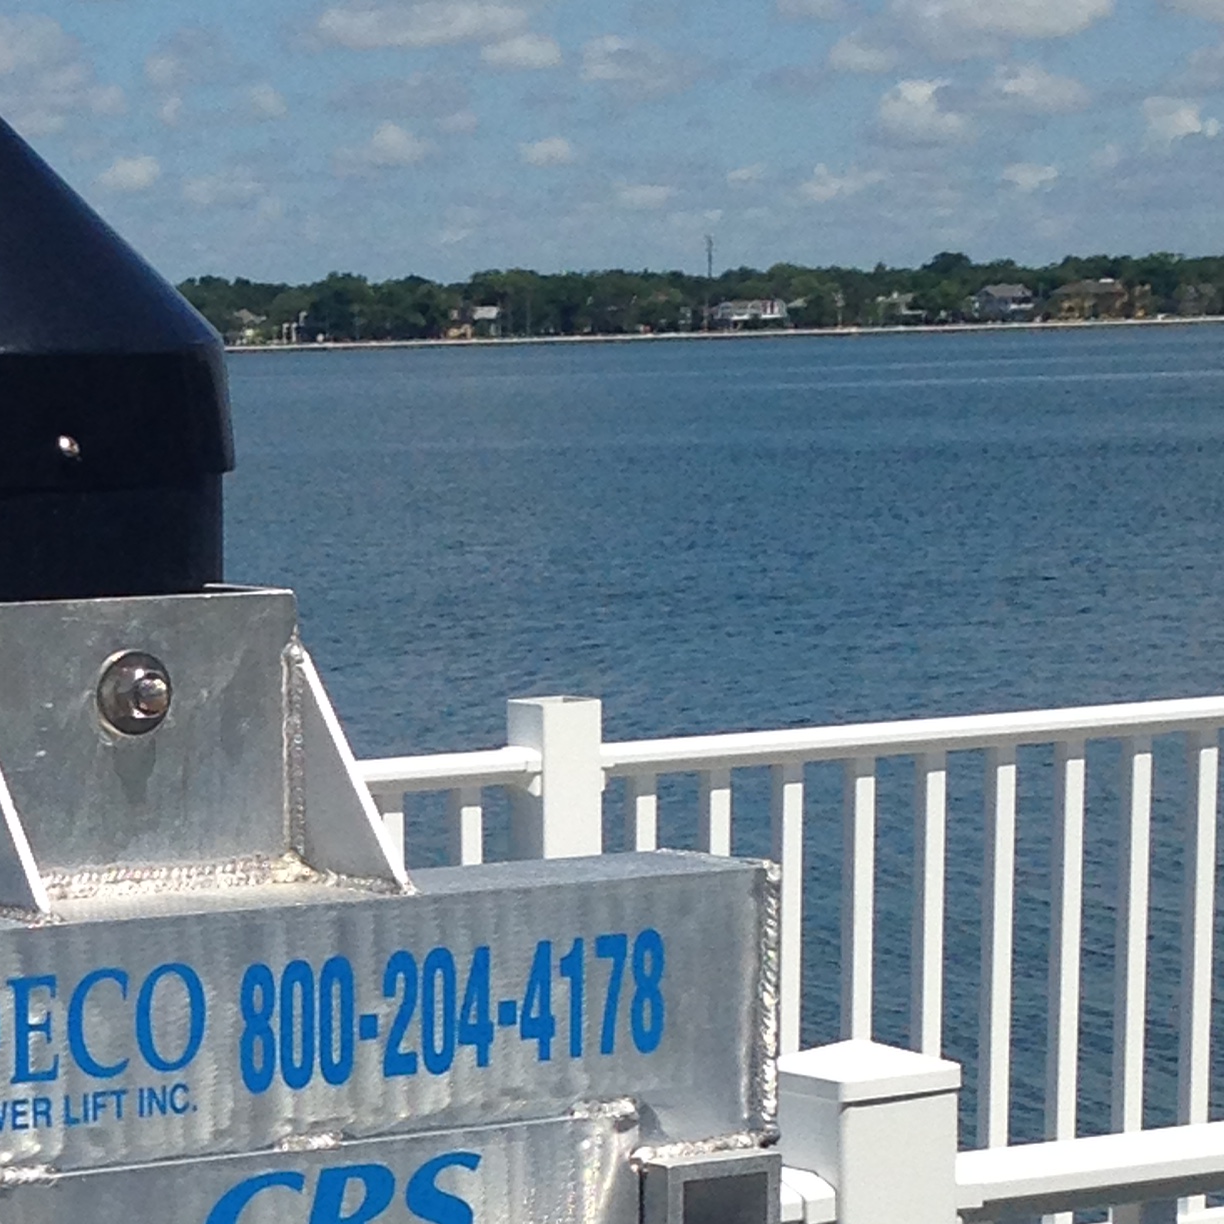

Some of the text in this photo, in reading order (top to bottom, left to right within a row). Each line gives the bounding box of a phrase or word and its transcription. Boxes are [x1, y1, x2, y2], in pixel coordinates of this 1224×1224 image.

[239, 927, 666, 1095] 800-204-4178
[63, 1089, 128, 1126] LIFT
[138, 1083, 198, 1119] INC.
